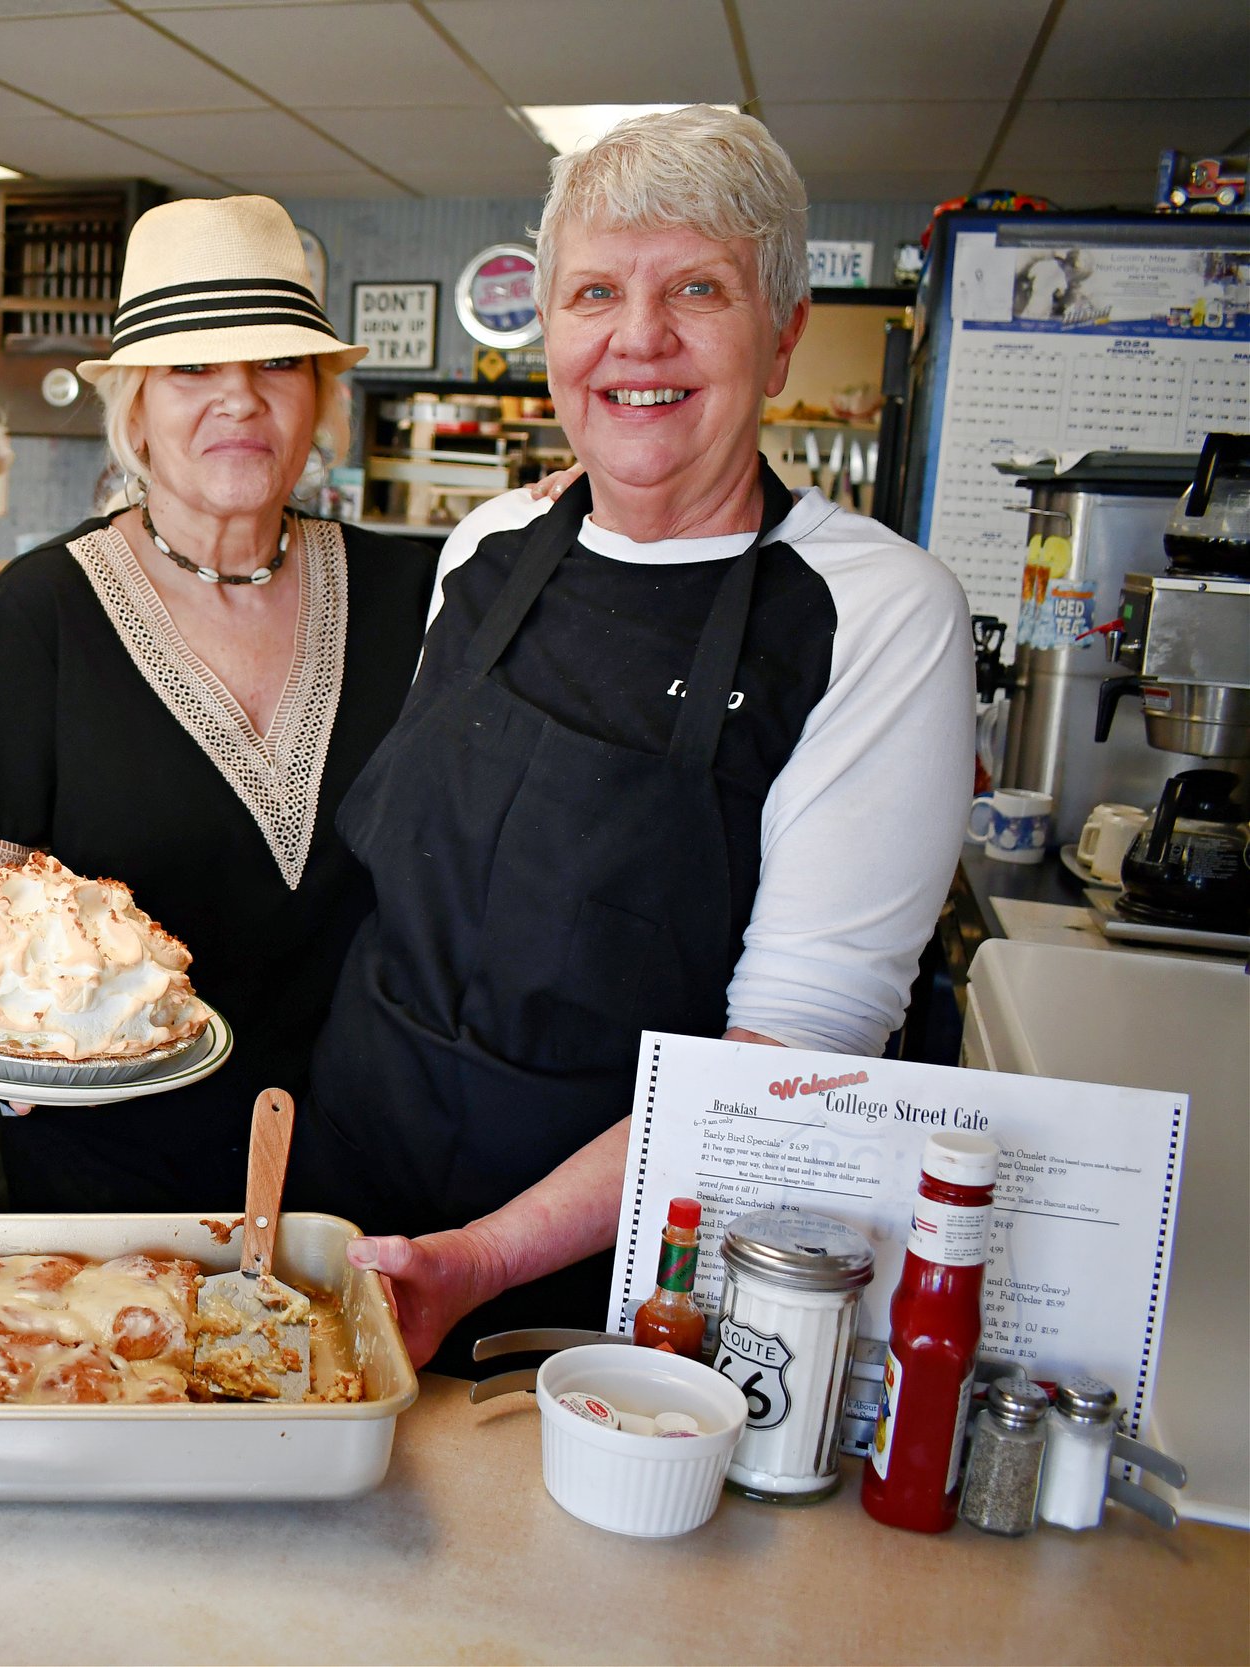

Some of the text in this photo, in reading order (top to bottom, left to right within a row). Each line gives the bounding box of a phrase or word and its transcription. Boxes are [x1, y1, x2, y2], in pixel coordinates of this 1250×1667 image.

[1111, 254, 1176, 264] Locally Made
[410, 319, 426, 333] UP
[377, 339, 427, 359] TRAP
[1114, 340, 1149, 348] 2024
[1054, 599, 1086, 618] ICED
[1055, 618, 1081, 636] TEA
[768, 1070, 869, 1101] Welcome
[712, 1099, 758, 1116] Breakfast
[825, 1090, 989, 1132] College Street Cafe
[703, 1129, 726, 1142] Early
[727, 1132, 746, 1143] Bird
[702, 1142, 710, 1150] #1
[712, 1143, 722, 1151] Two
[723, 1146, 736, 1154] eggs
[737, 1147, 748, 1155] your
[762, 1151, 780, 1159] choice
[803, 1156, 835, 1167] hashbrowns
[836, 1160, 846, 1168] and
[847, 1162, 861, 1170] toast
[1016, 1148, 1047, 1162] Omelet
[1065, 1158, 1080, 1166] based
[711, 1154, 722, 1163] Two
[722, 1157, 735, 1165] eggs
[762, 1162, 779, 1171] choice
[823, 1170, 838, 1179] silver
[838, 1173, 855, 1181] dollar
[855, 1176, 881, 1185] pancakes
[1014, 1160, 1044, 1173] Omelet
[1047, 1166, 1067, 1175] $9.99
[1015, 1174, 1035, 1183] $9.99
[698, 1180, 718, 1189] served
[718, 1183, 734, 1191] from
[740, 1185, 750, 1193] till
[1005, 1185, 1024, 1193] $7.99
[696, 1190, 775, 1210] Breakfast Sandwich
[1017, 1195, 1034, 1205] Toast
[1043, 1199, 1066, 1209] Biscuit
[1066, 1203, 1080, 1211] and
[1079, 1203, 1100, 1214] Gravy
[702, 1206, 717, 1214] white
[993, 1220, 1014, 1230] $4.49
[698, 1249, 714, 1257] tato
[989, 1246, 1004, 1254] 4.99
[701, 1260, 726, 1271] hashbrow
[694, 1273, 711, 1281] opped
[986, 1278, 1070, 1296] and Country Gravy)
[1000, 1290, 1065, 1307] Full Order $5.99
[1025, 1322, 1038, 1332] OJ
[994, 1330, 1009, 1341] Tea
[724, 1325, 778, 1361] ROUTE
[979, 1343, 999, 1352] duct
[999, 1347, 1015, 1355] can
